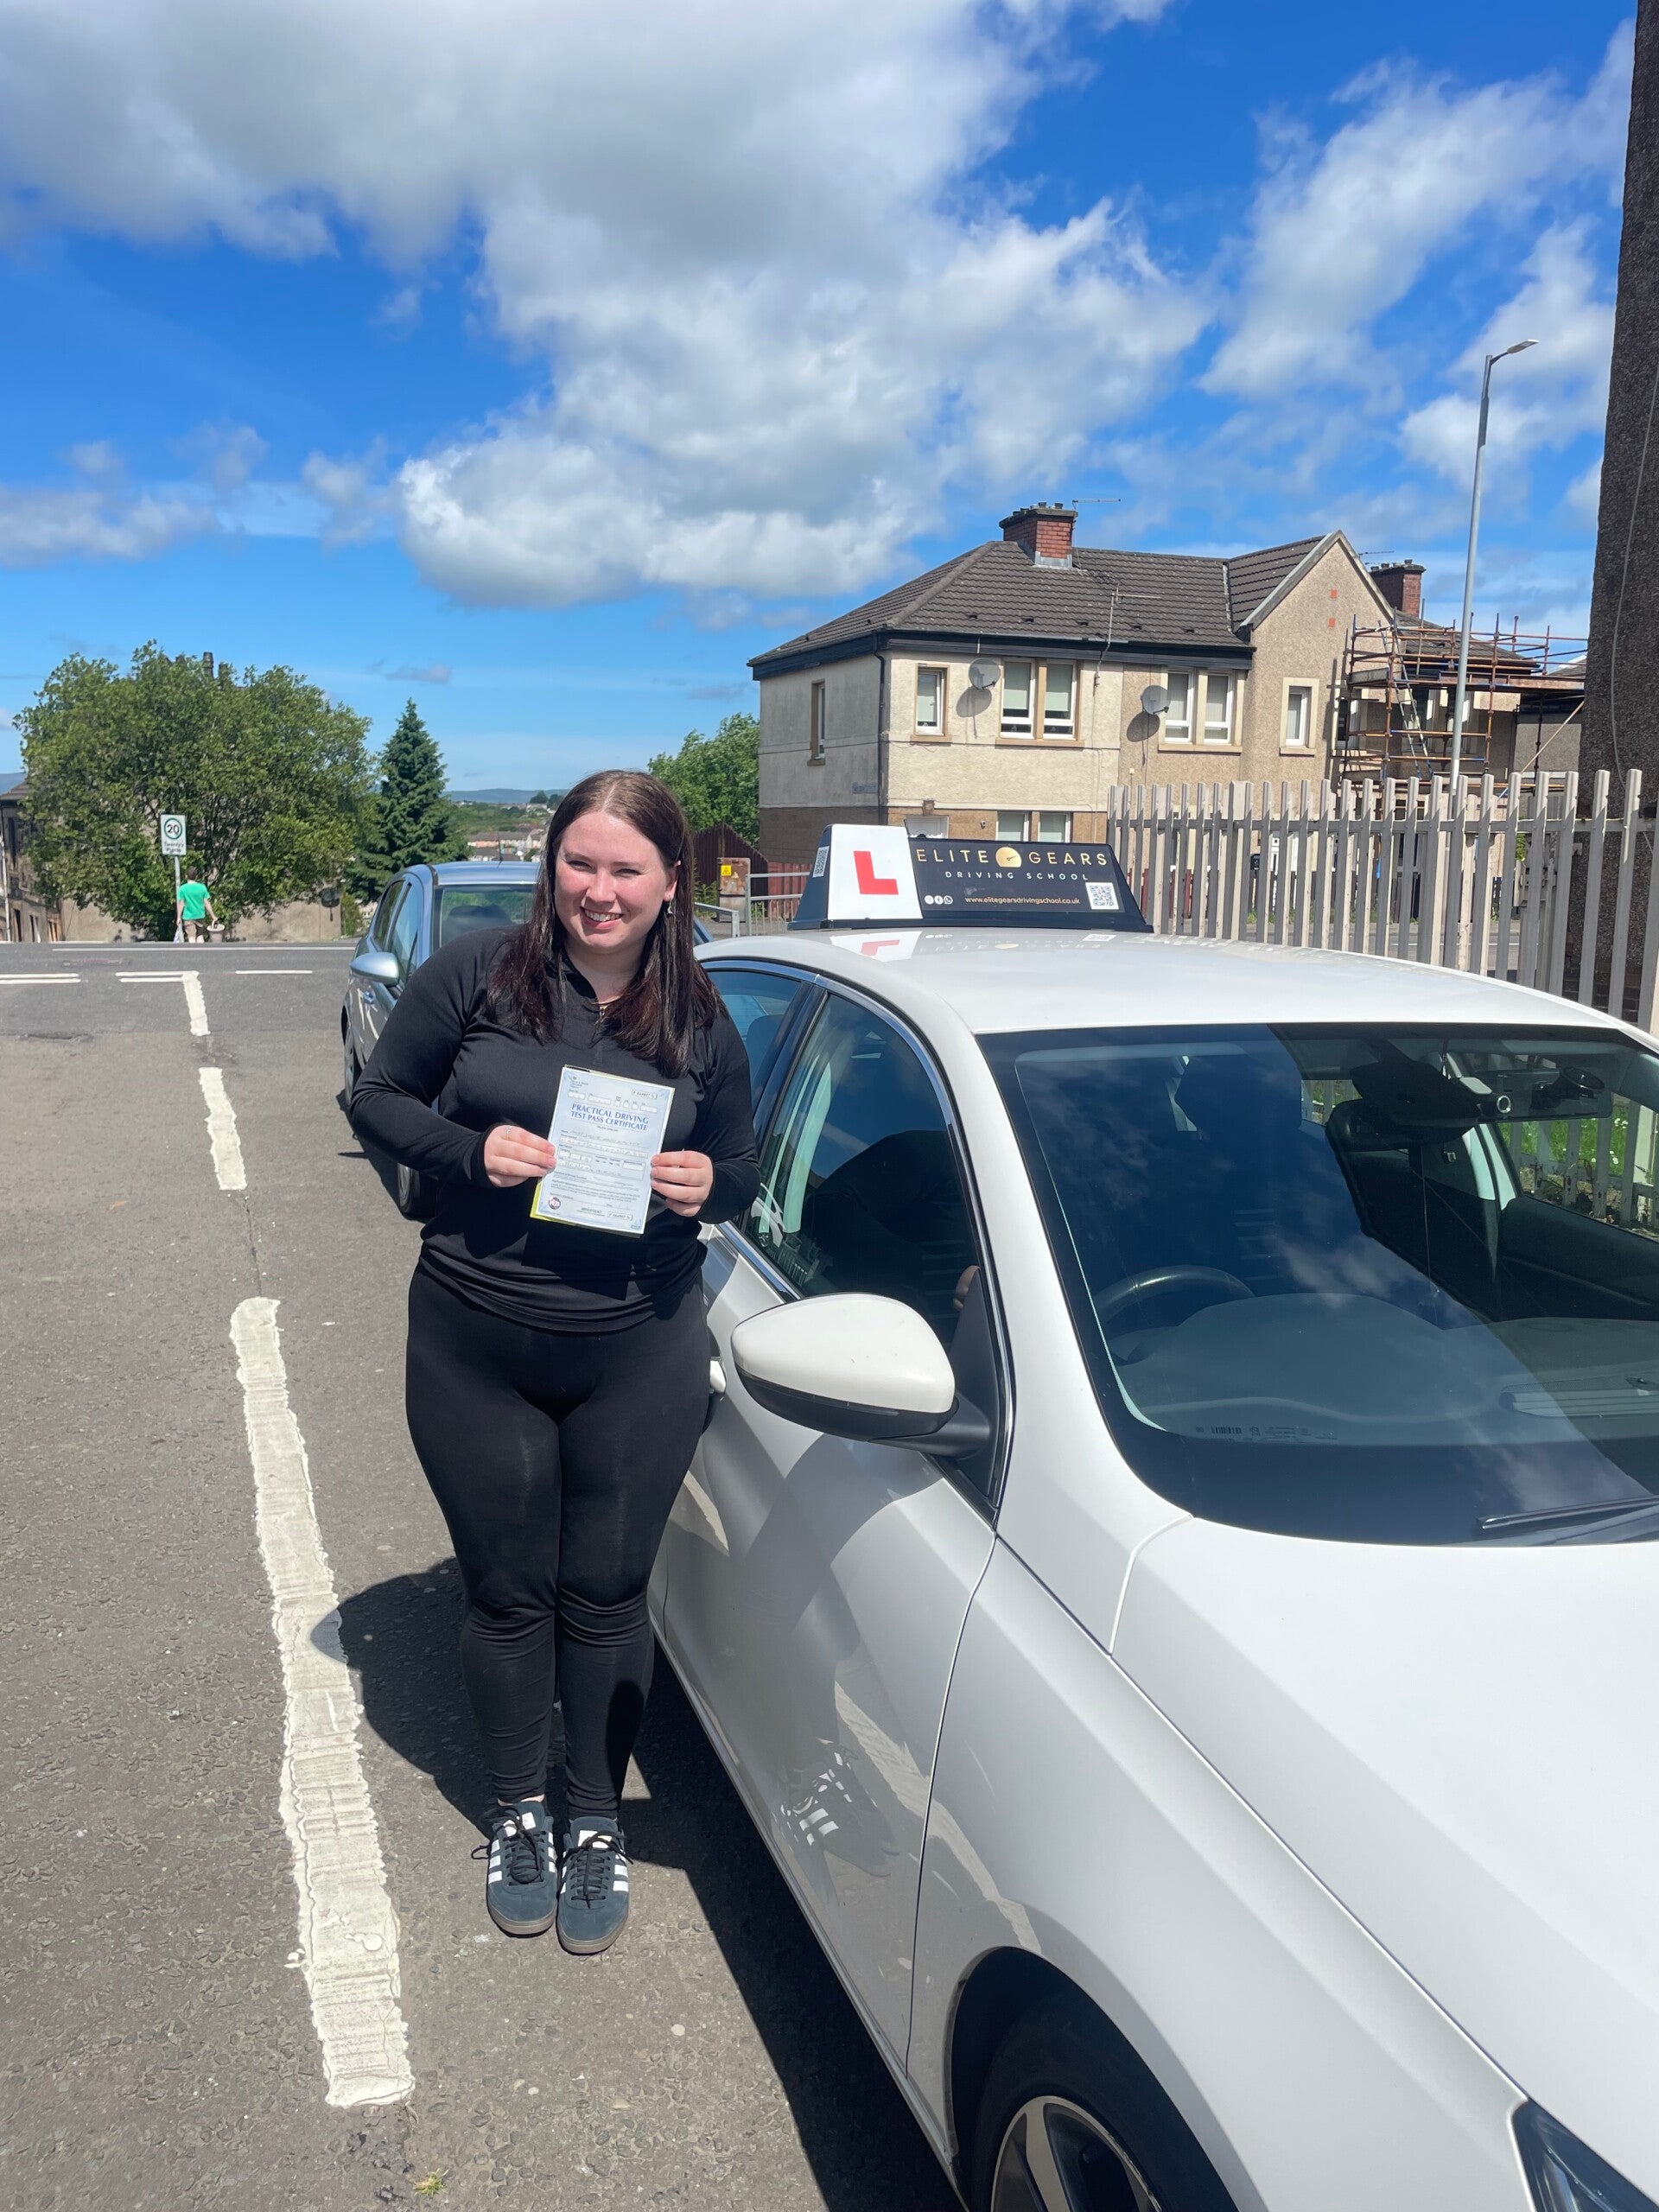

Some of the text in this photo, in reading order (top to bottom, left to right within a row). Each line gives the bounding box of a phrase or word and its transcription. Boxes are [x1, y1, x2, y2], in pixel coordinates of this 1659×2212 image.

[167, 824, 180, 835] 20
[916, 849, 1108, 866] ELITE GEARS
[853, 850, 899, 895] L
[1027, 872, 1089, 880] SCHOOL
[964, 896, 1081, 905] www.elitegearsdrivingschool.co.uk
[571, 1103, 649, 1124] PRACTICAL DRIVING
[571, 1111, 586, 1120] TEST
[588, 1113, 604, 1123] PASS
[605, 1117, 648, 1131] CERTIFICATE
